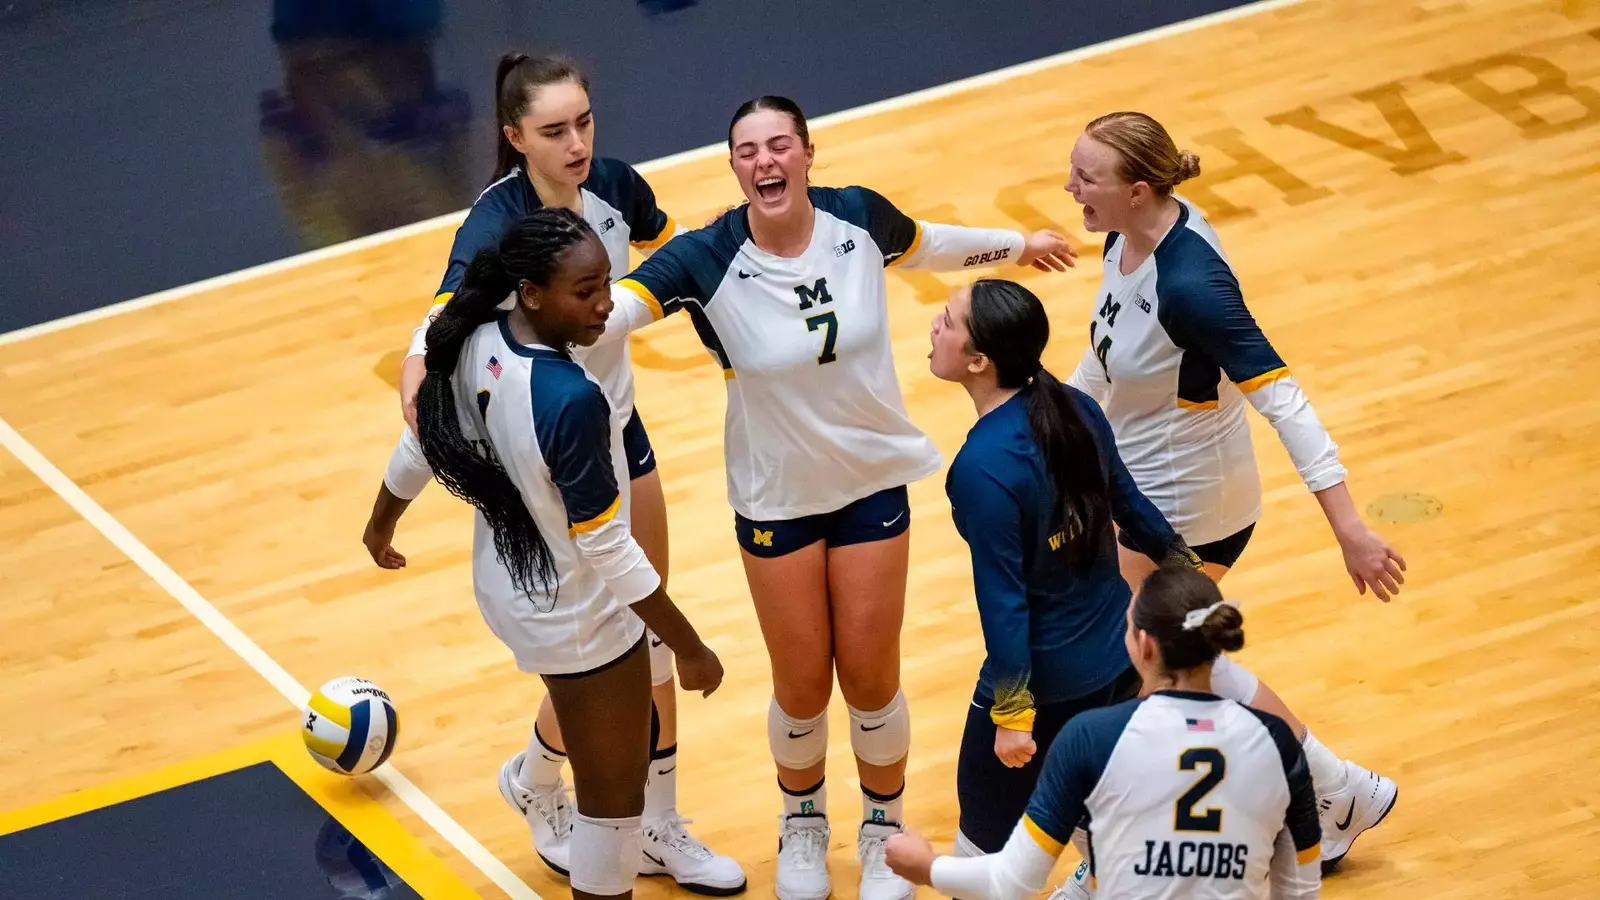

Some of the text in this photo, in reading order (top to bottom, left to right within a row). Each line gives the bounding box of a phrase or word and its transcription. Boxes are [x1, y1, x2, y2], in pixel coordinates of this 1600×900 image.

[963, 247, 1011, 267] GO BLUE
[793, 277, 833, 310] M
[1099, 292, 1121, 328] M
[805, 310, 838, 365] 7
[753, 528, 773, 547] M
[306, 712, 318, 732] M
[1173, 747, 1227, 834] 2
[1134, 839, 1249, 880] JACOBS
